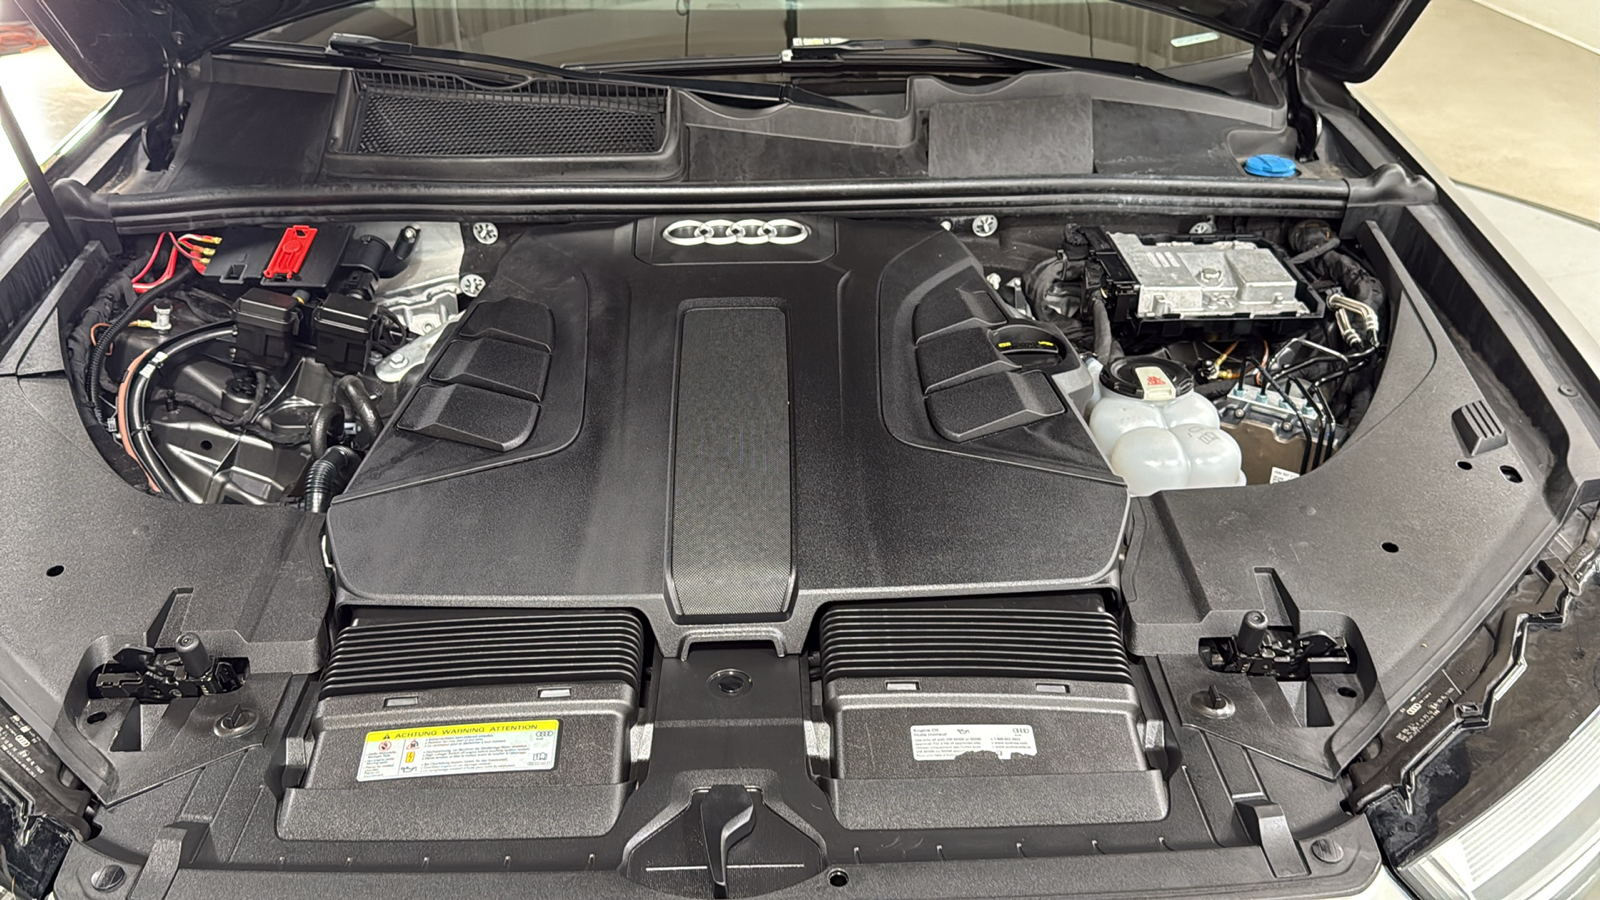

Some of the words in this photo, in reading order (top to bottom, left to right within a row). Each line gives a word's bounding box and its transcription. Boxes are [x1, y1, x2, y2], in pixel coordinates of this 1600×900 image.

[394, 730, 438, 739] ACHTUNG
[442, 726, 485, 735] WARNING
[489, 724, 538, 732] ATTENTION
